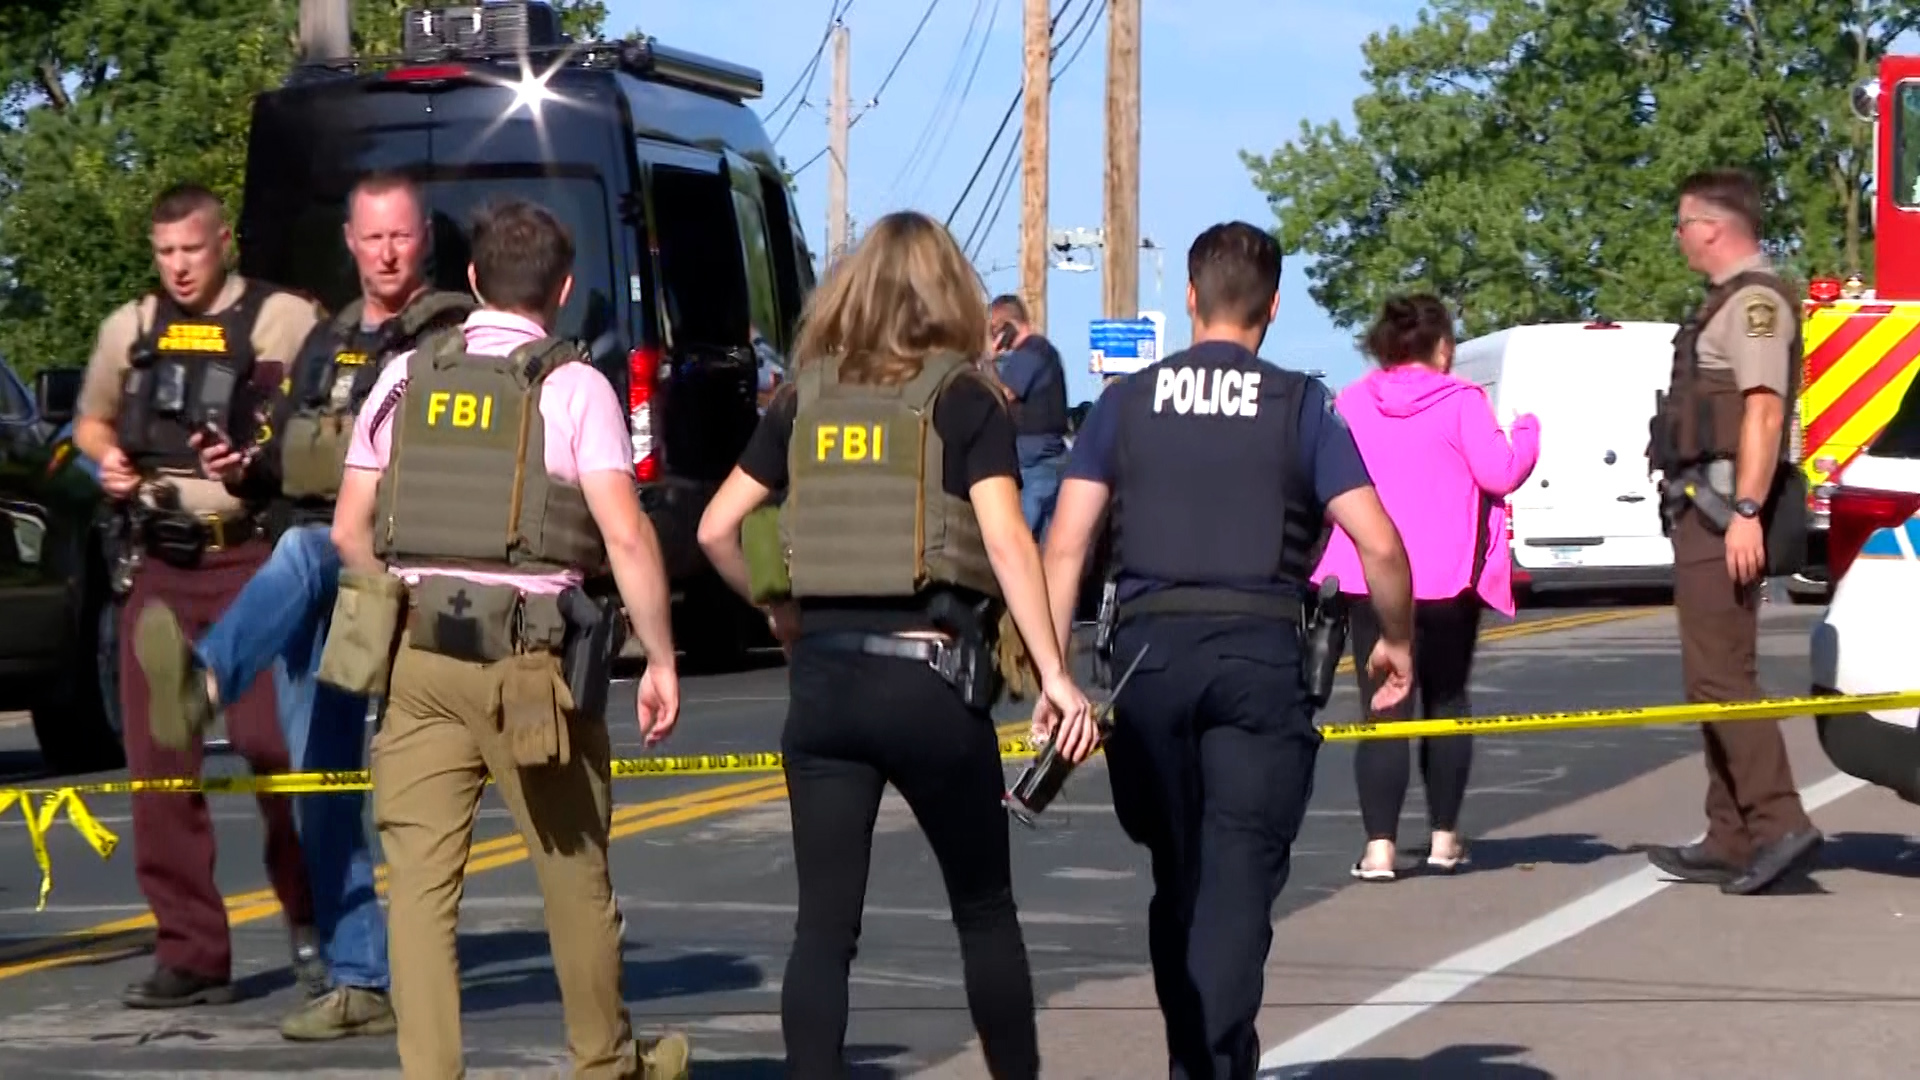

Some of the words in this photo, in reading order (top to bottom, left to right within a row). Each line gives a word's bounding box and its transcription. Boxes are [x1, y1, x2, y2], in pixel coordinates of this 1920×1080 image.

[426, 391, 493, 431] FBI
[1153, 366, 1261, 418] POLICE
[815, 423, 882, 464] FBI
